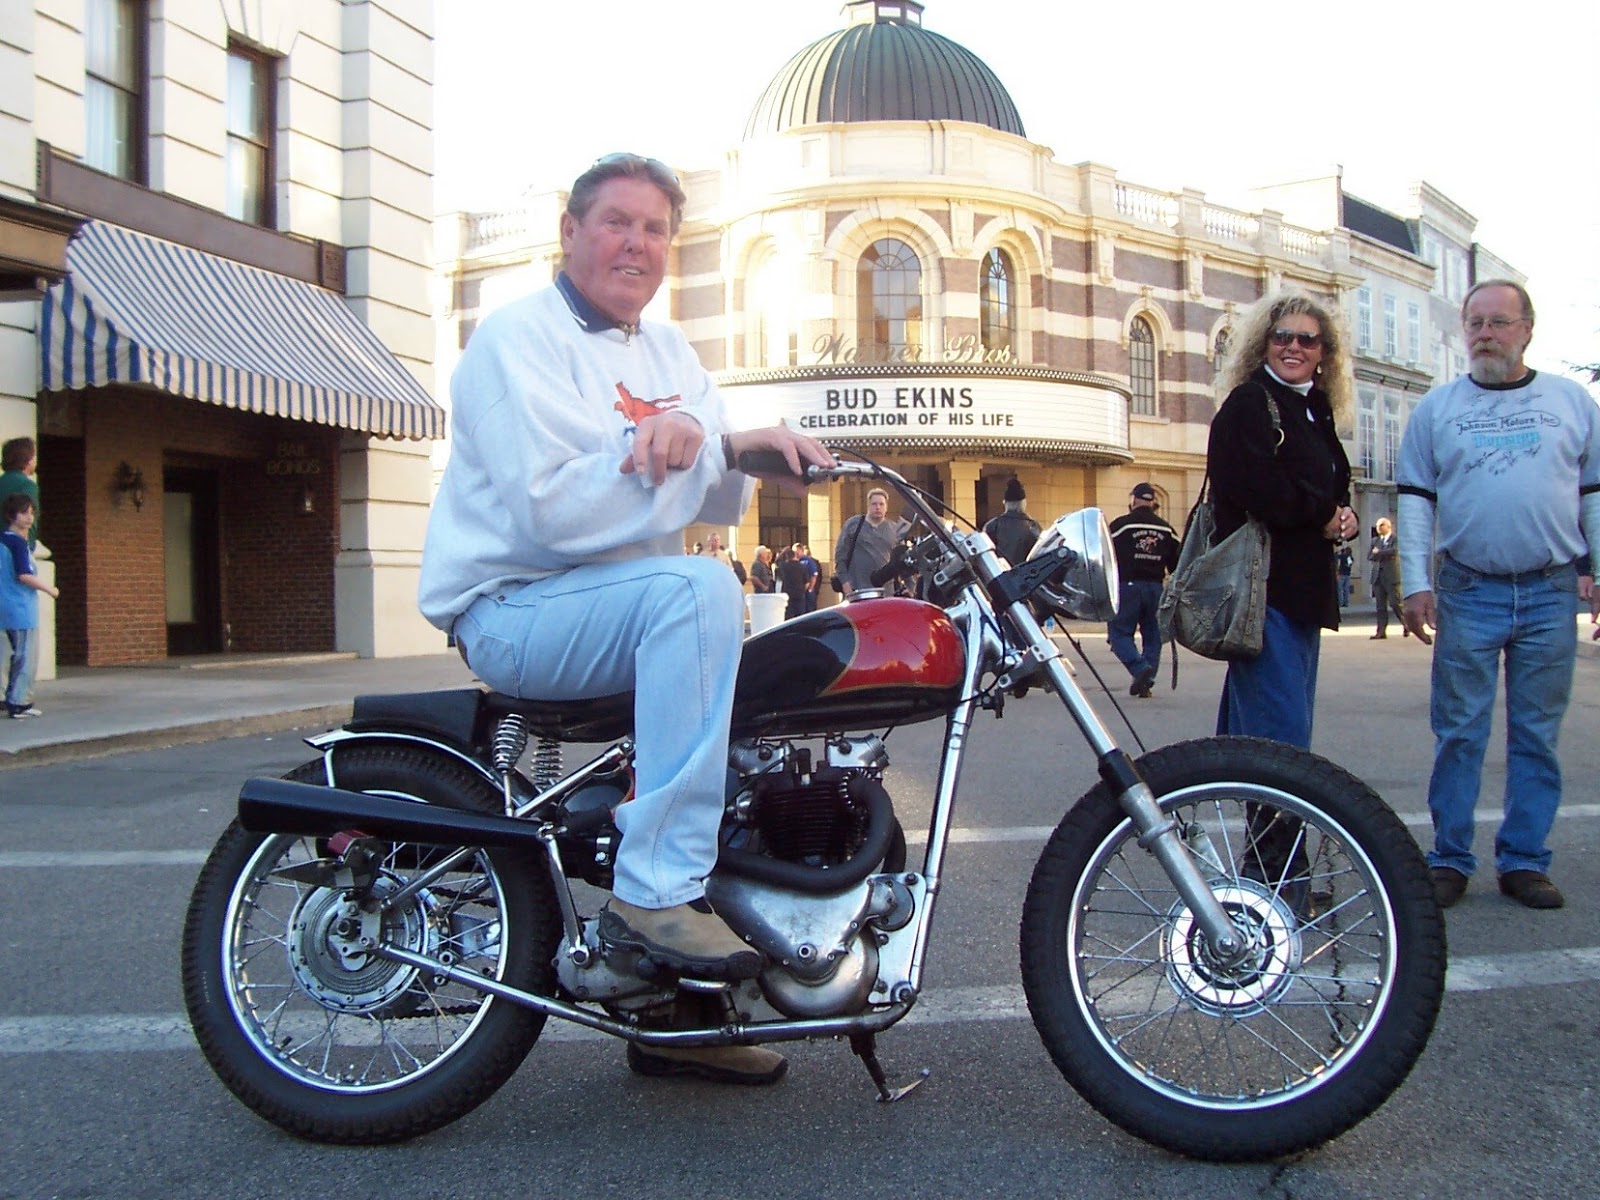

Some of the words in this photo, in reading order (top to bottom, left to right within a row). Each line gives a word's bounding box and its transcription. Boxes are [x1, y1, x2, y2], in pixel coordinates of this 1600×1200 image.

[812, 332, 924, 365] Waner
[826, 387, 878, 410] BUD
[894, 386, 974, 409] EKINS
[799, 412, 908, 429] CELEBRATION
[917, 412, 940, 426] OF
[948, 412, 975, 426] HIS
[981, 413, 1015, 427] LIFE
